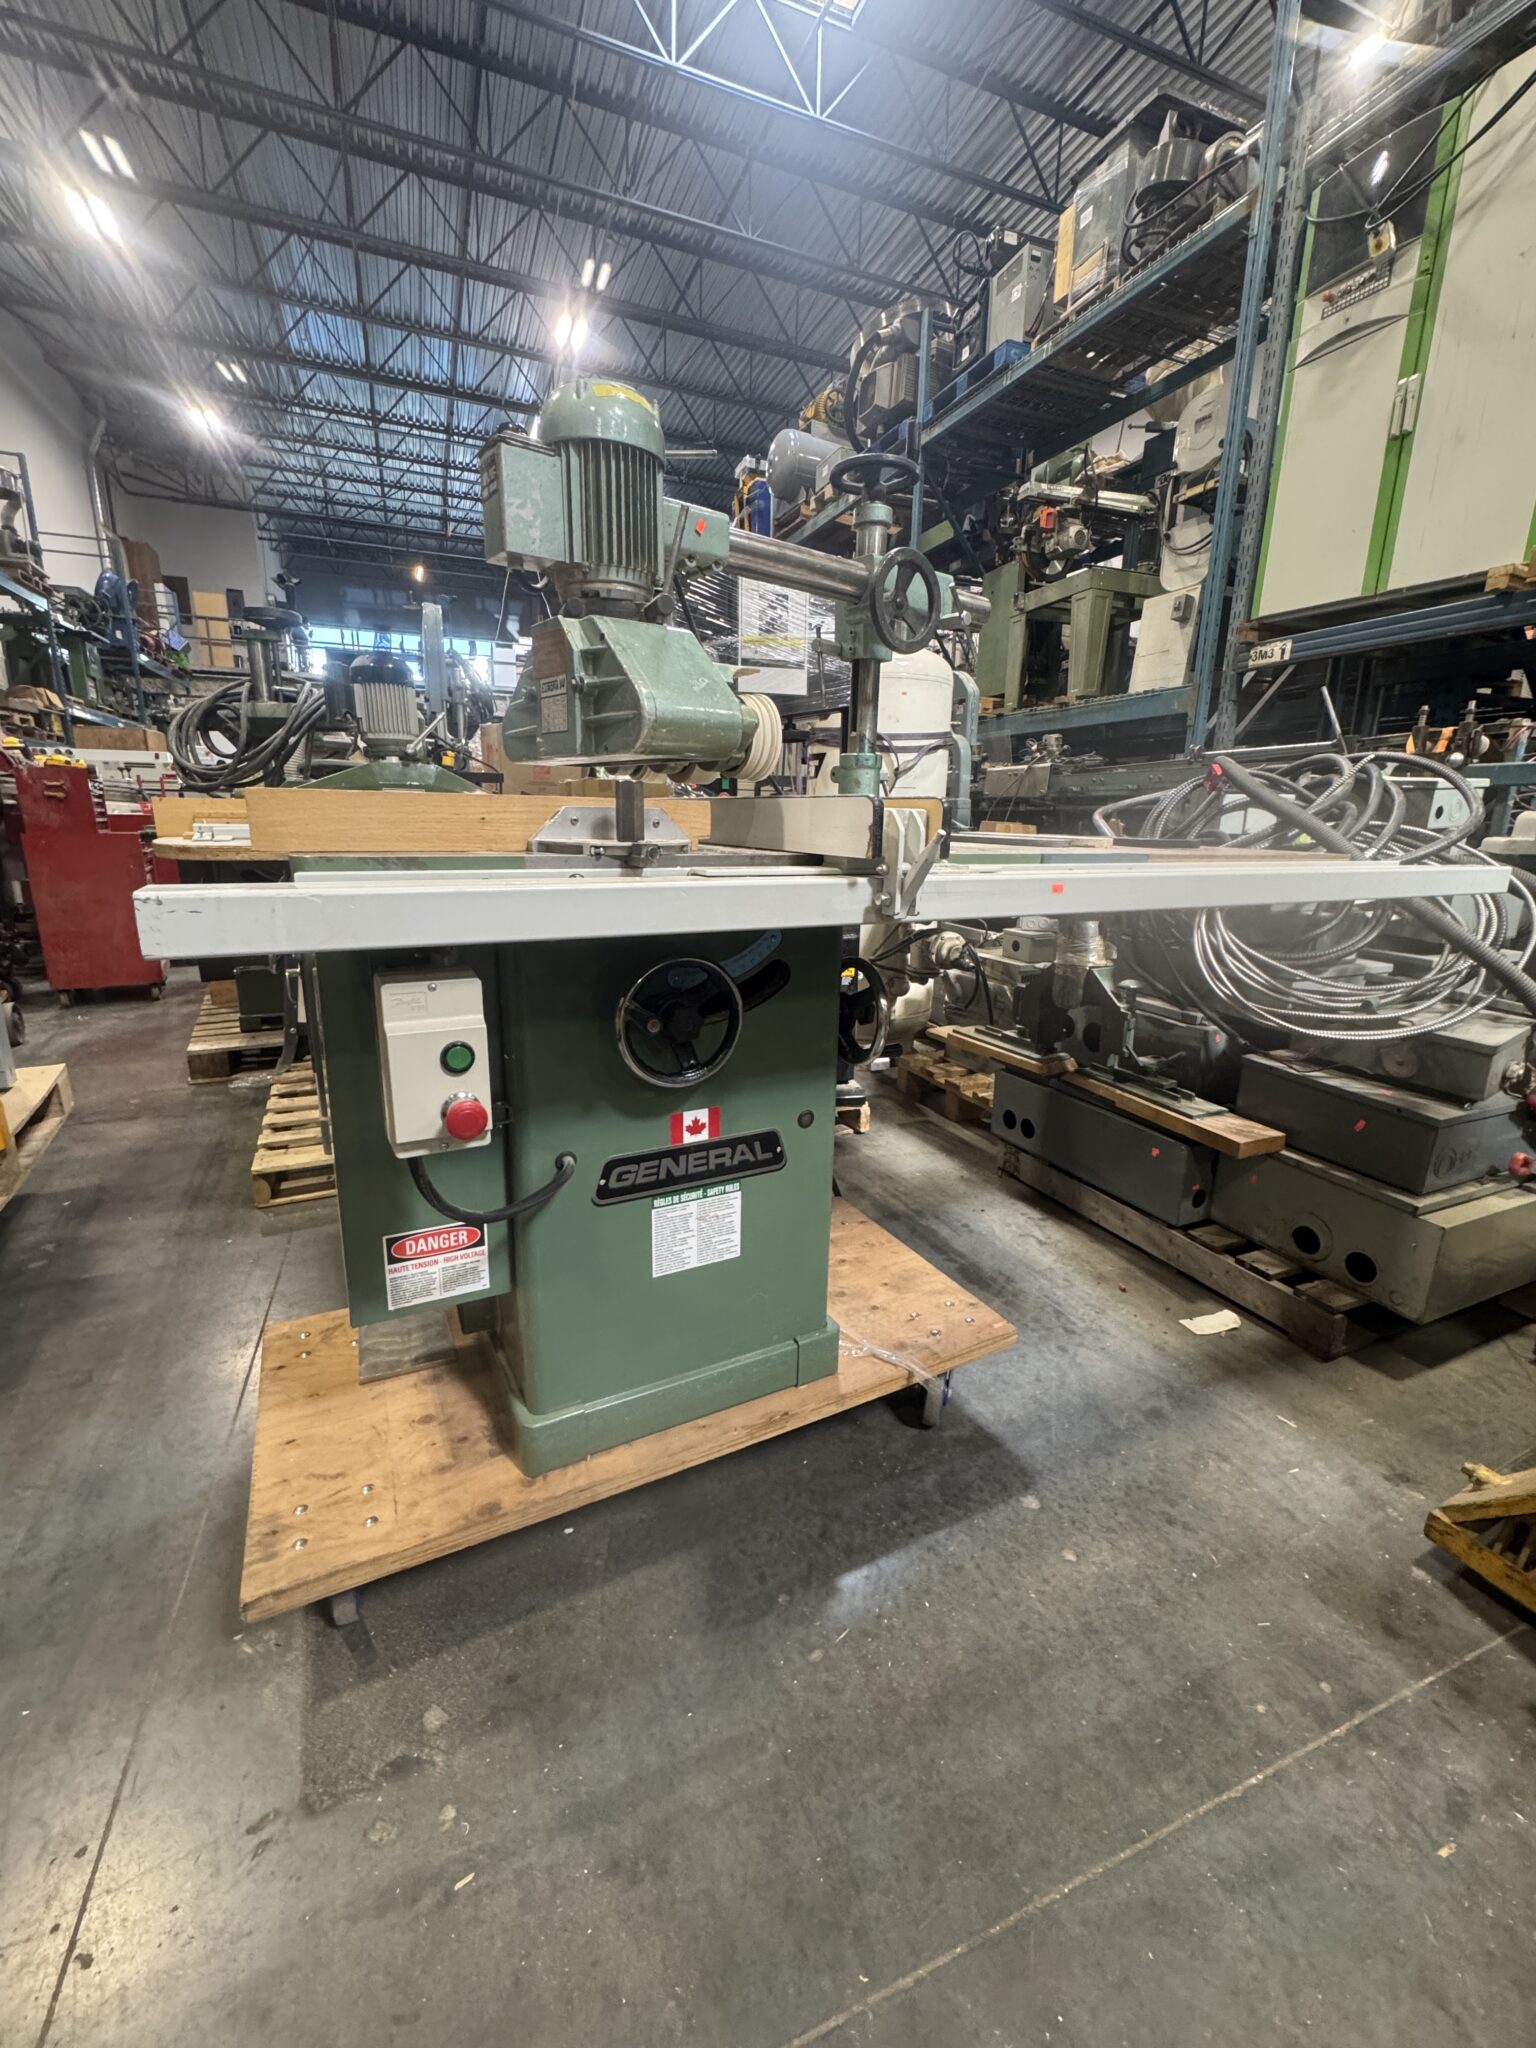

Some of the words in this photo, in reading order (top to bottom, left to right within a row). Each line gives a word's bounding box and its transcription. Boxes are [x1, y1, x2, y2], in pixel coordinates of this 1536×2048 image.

[608, 1141, 773, 1189] GENERAL
[707, 1186, 725, 1197] SAFETY
[725, 1182, 740, 1193] RULES
[405, 1230, 468, 1255] DANGER
[388, 1265, 409, 1275] HAUTE
[411, 1259, 439, 1270] TENSION
[443, 1253, 458, 1263] HIGH
[459, 1249, 486, 1260] VOLTAGE
